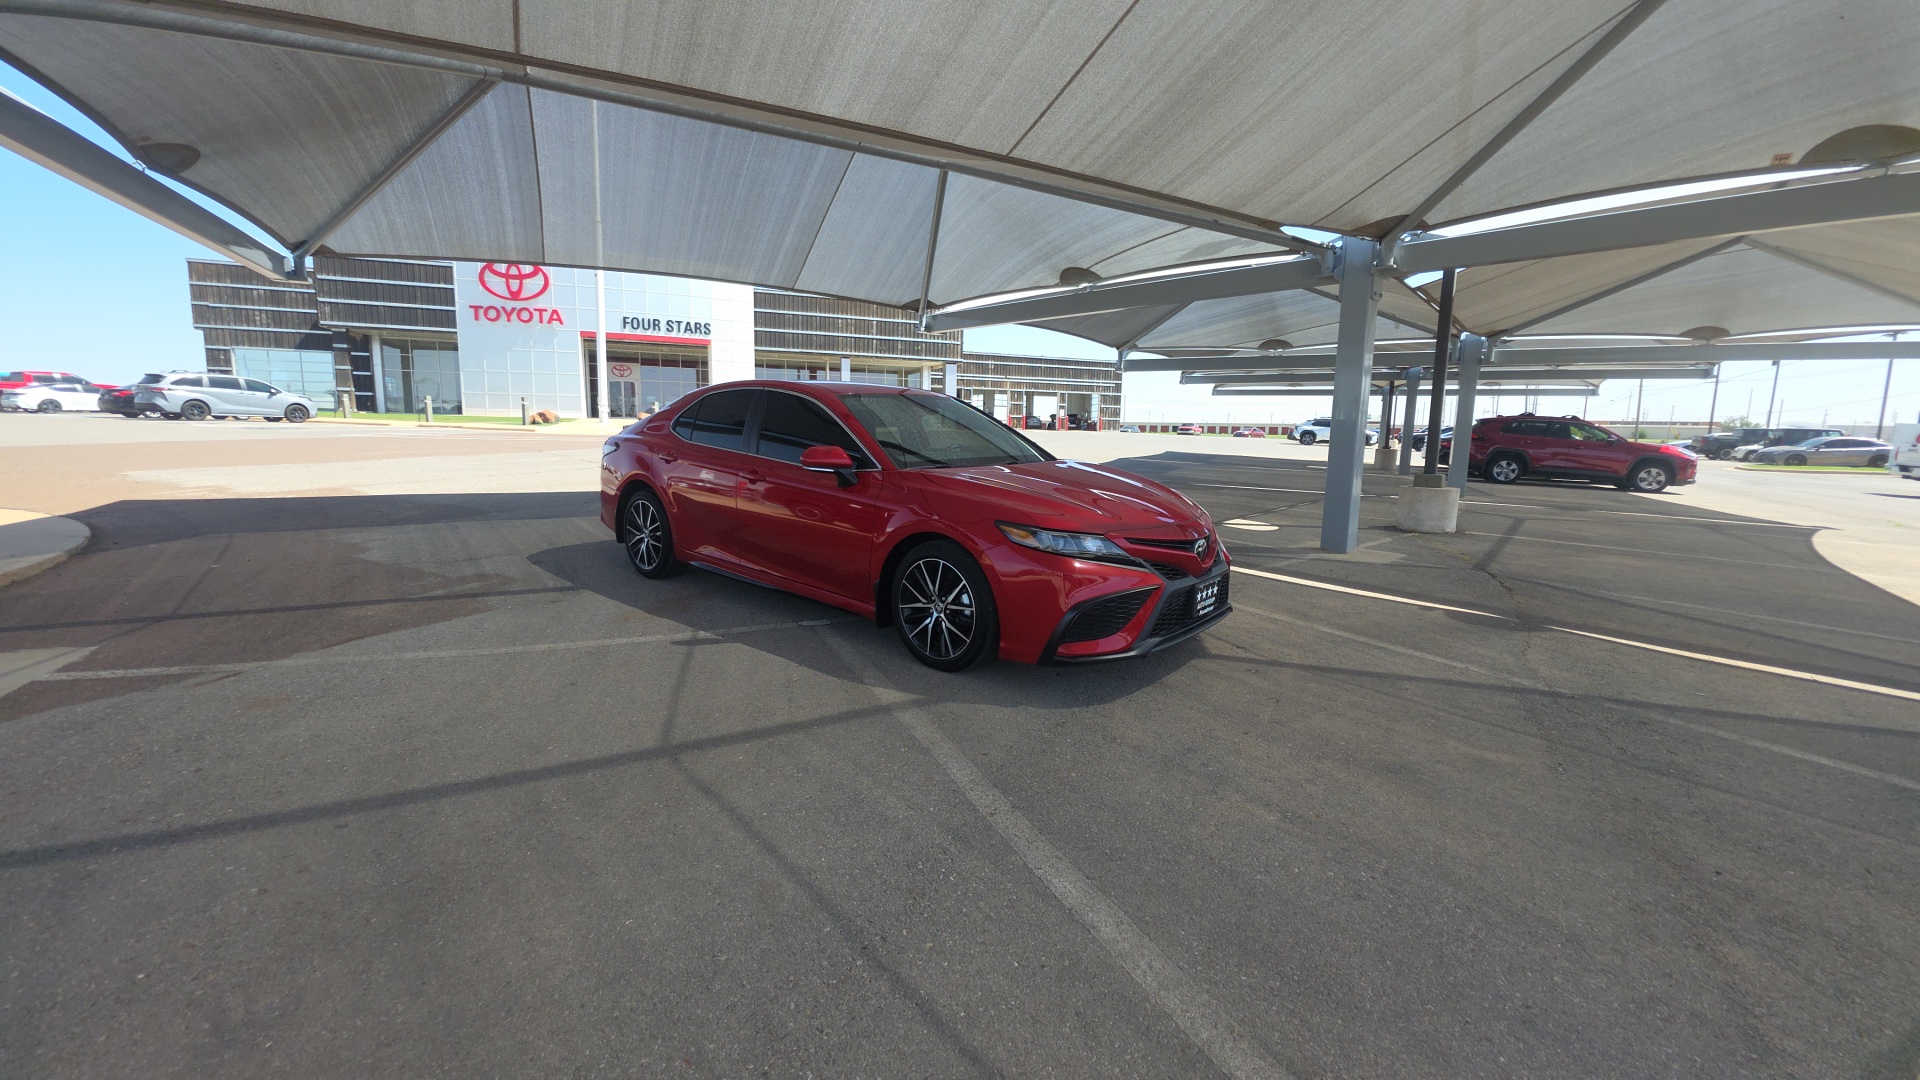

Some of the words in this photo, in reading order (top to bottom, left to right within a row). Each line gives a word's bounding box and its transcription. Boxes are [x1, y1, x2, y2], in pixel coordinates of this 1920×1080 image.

[468, 305, 564, 325] TOYOTA
[622, 316, 661, 332] FOUR
[665, 319, 712, 336] STARS
